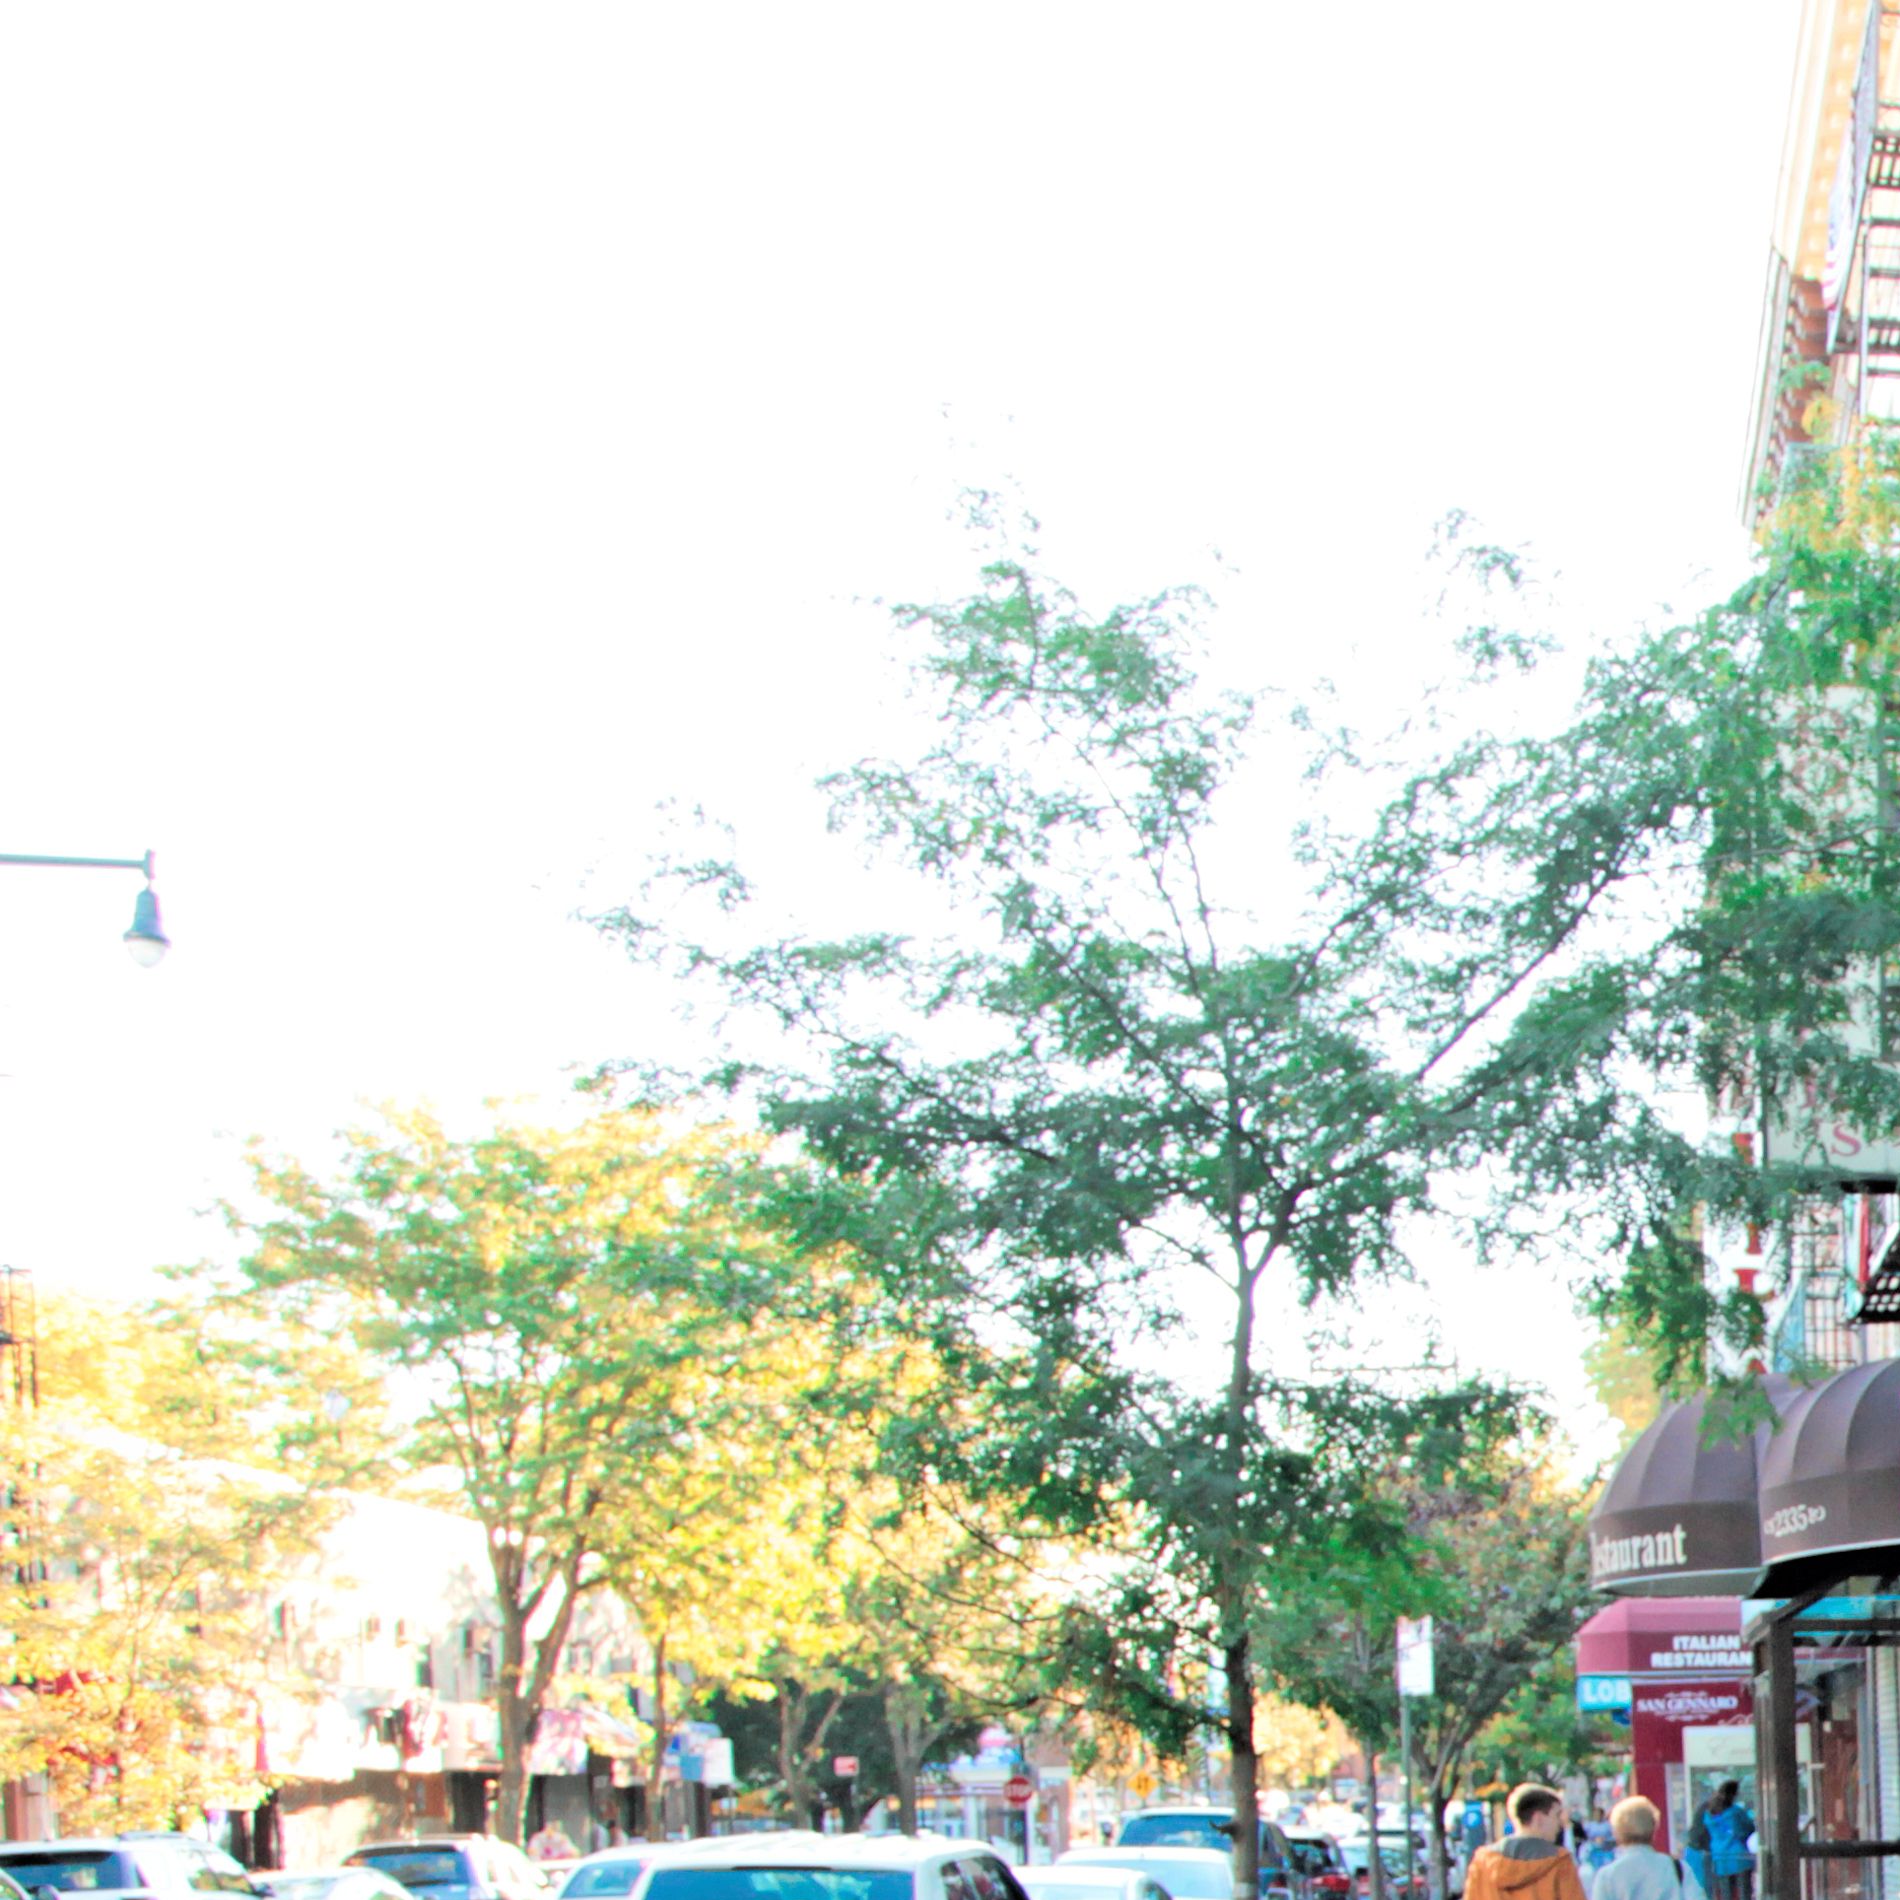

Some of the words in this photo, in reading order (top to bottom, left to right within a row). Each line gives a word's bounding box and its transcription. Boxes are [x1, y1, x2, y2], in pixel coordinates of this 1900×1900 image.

[1591, 1523, 1688, 1577] staurant
[1672, 1634, 1742, 1651] ITALIAN
[1650, 1651, 1754, 1669] RESTAURAN
